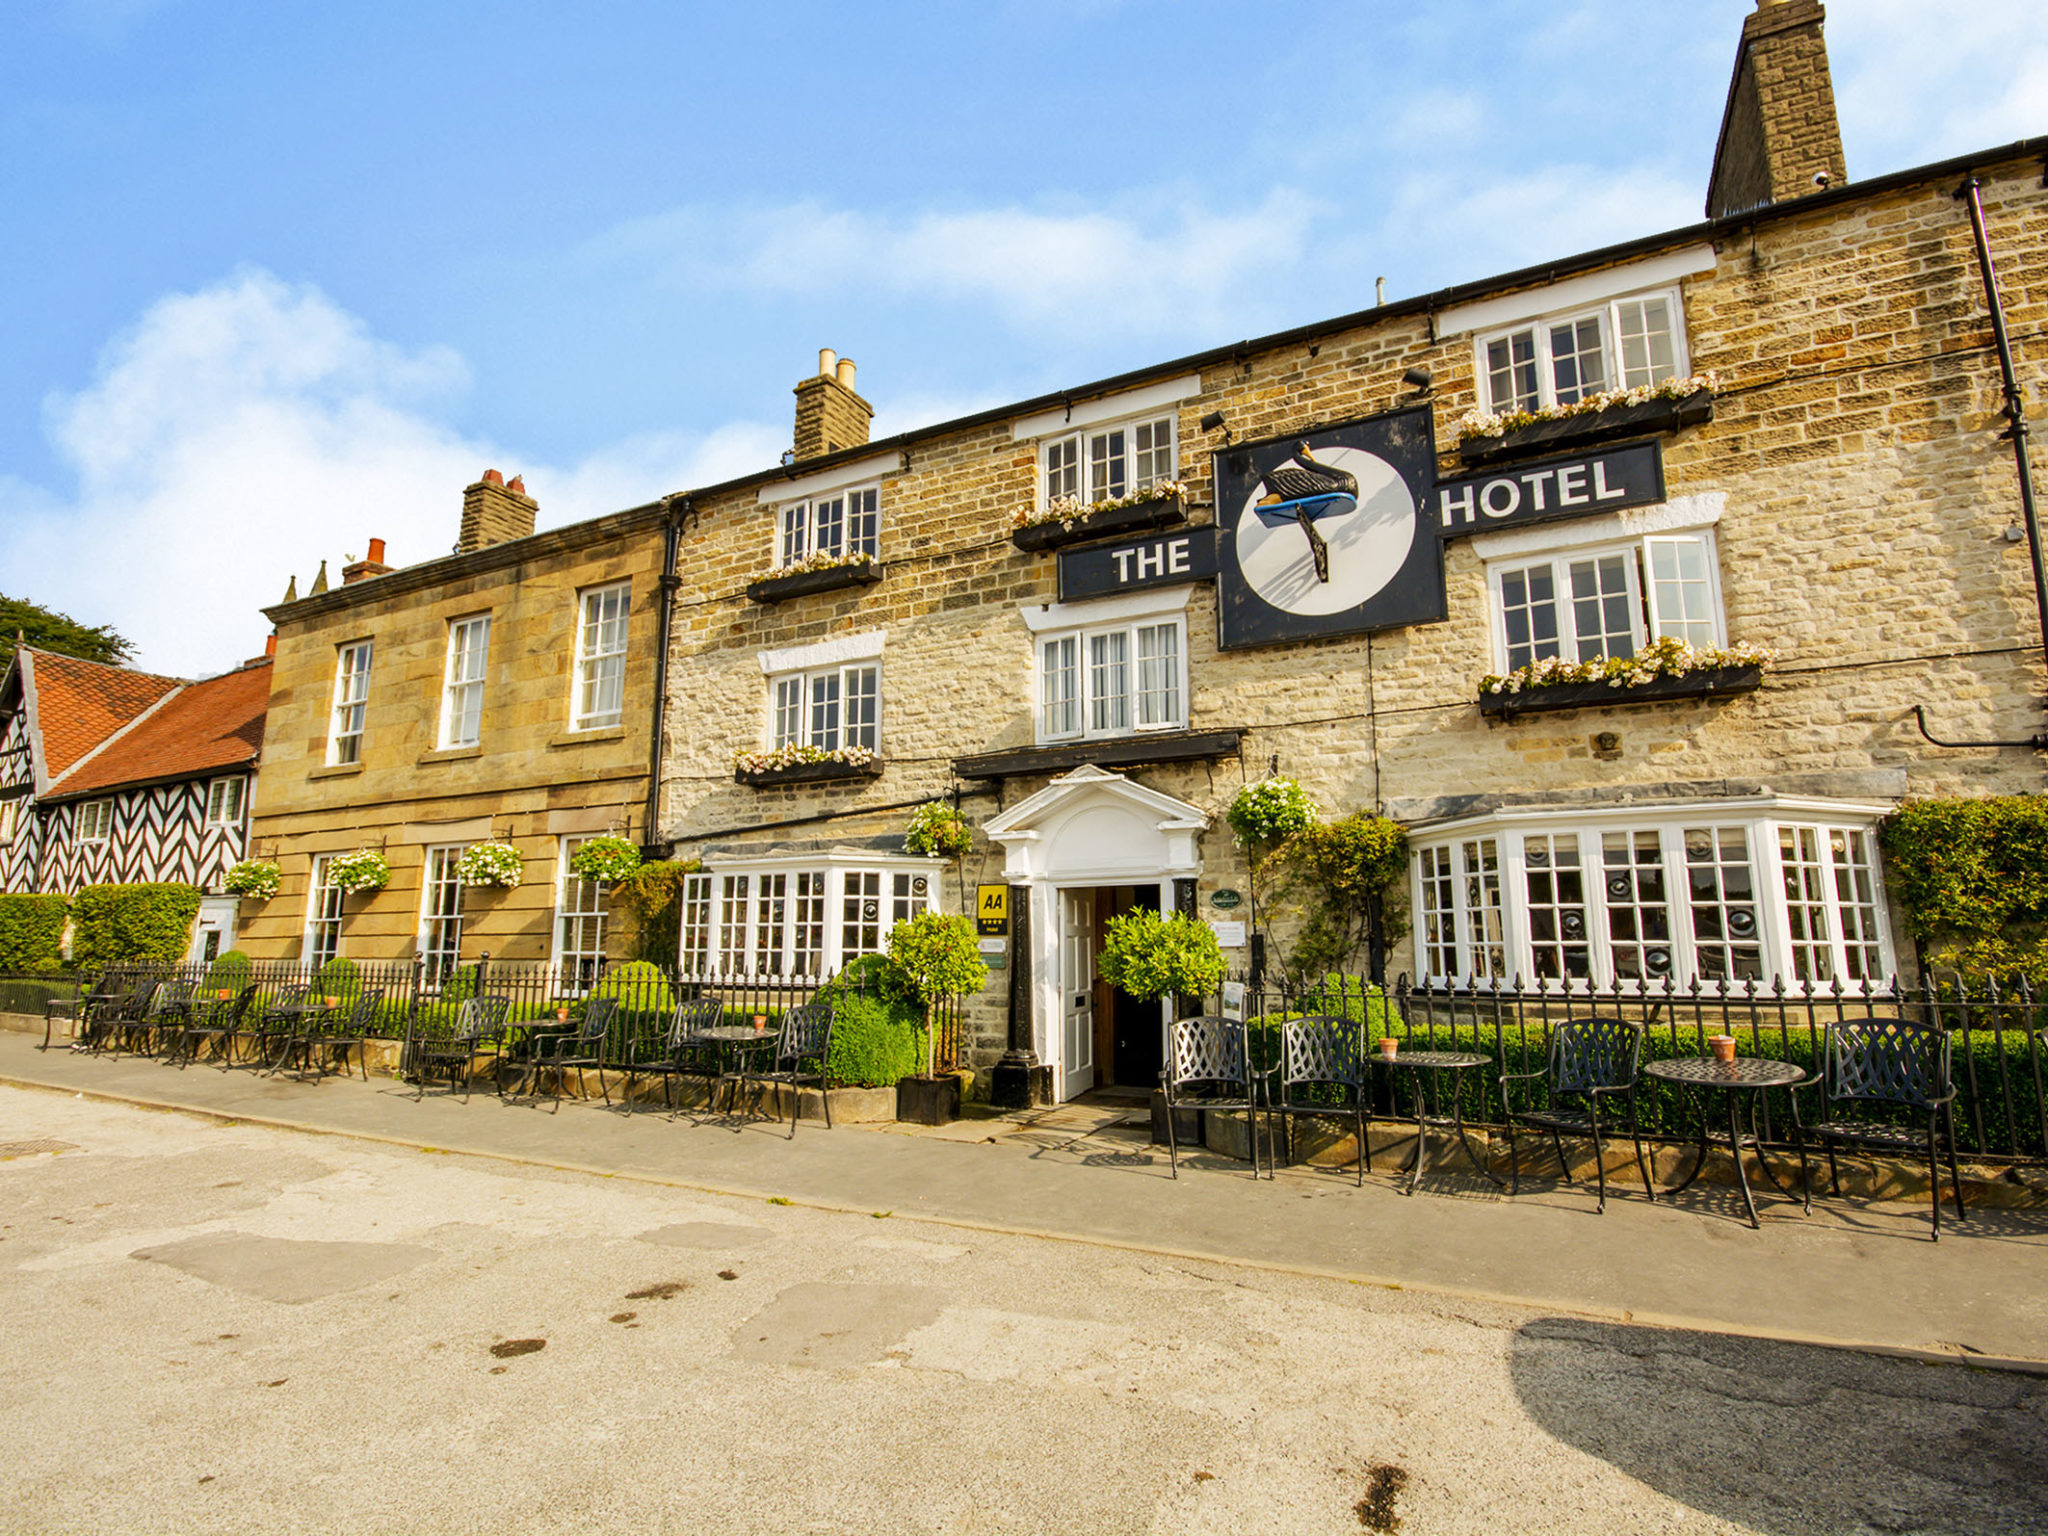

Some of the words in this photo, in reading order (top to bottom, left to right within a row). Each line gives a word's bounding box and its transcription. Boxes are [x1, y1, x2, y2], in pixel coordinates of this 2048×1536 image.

[1112, 538, 1191, 582] THE
[1440, 461, 1625, 527] HOTEL
[983, 894, 1002, 910] AA
